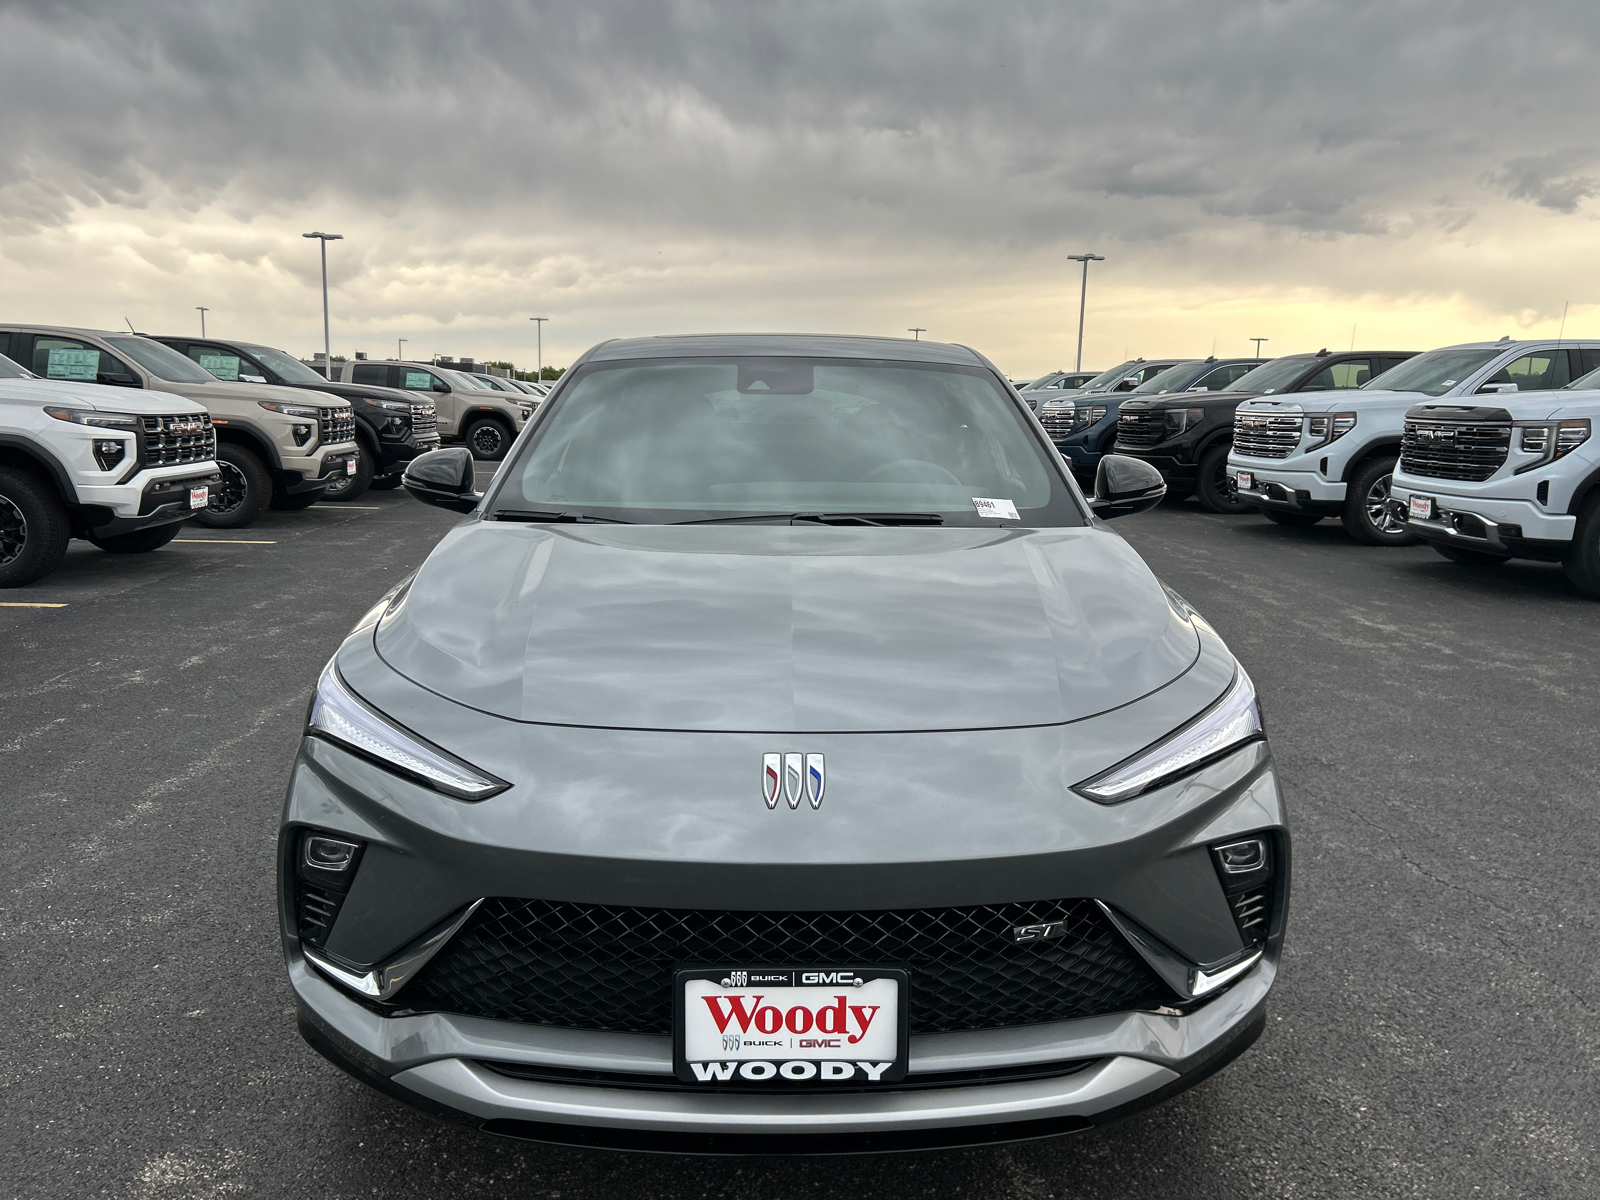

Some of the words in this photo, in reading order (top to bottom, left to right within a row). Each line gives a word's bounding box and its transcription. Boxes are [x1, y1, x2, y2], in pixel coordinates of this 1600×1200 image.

[1416, 430, 1455, 442] GMC
[802, 972, 854, 984] GMC
[701, 995, 880, 1044] Woody
[799, 1038, 841, 1048] GMC
[690, 1060, 893, 1081] WOODY
